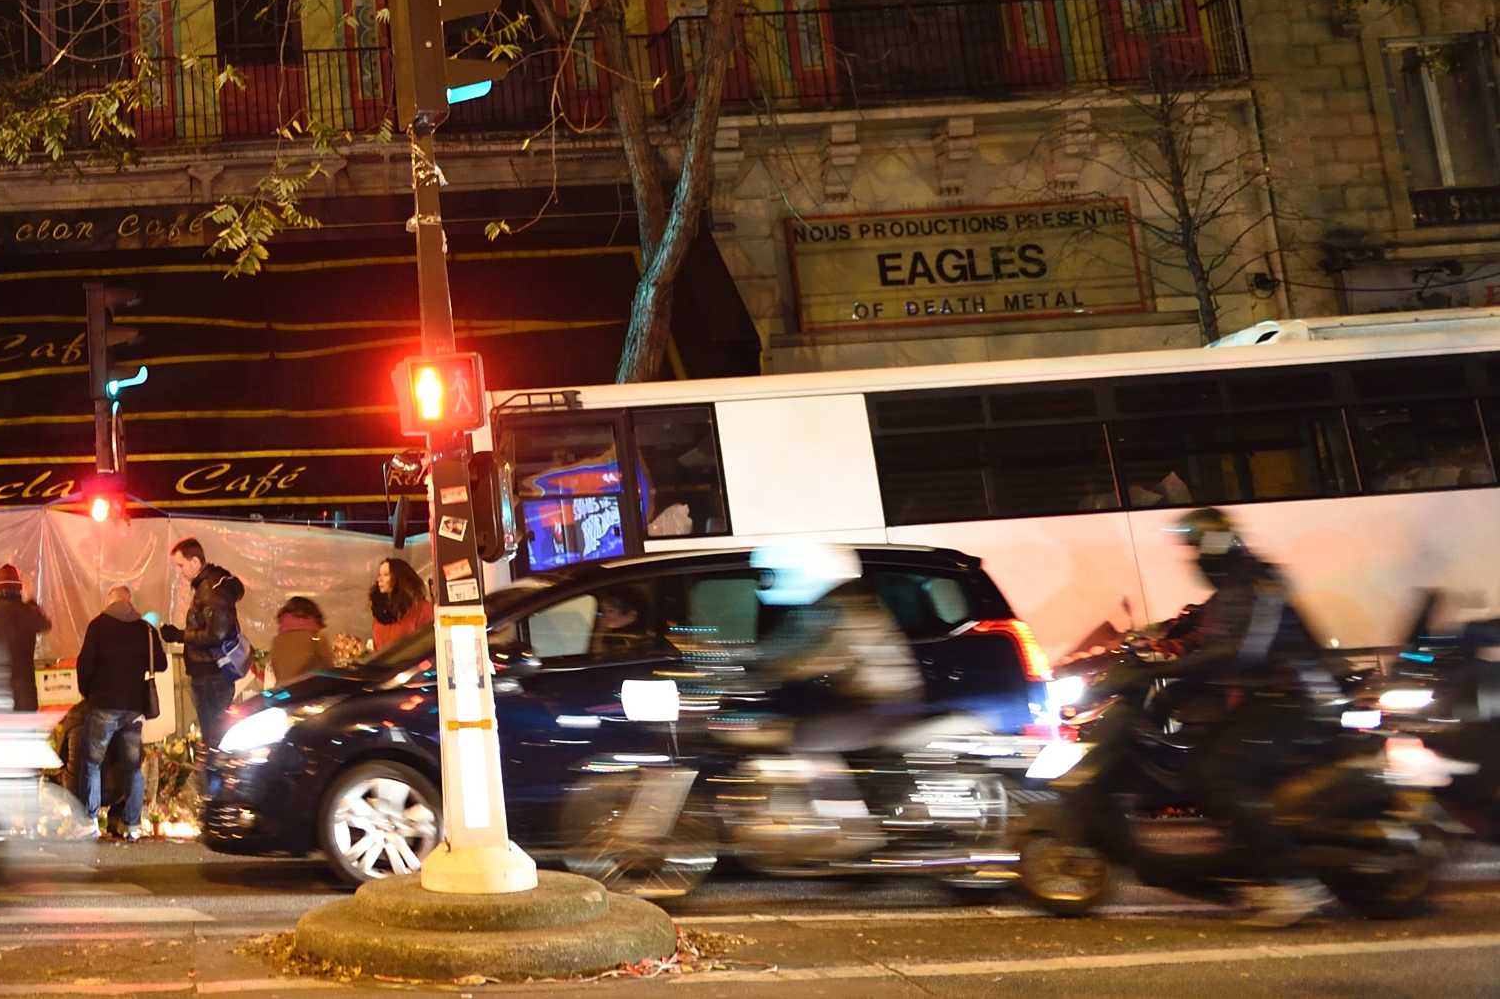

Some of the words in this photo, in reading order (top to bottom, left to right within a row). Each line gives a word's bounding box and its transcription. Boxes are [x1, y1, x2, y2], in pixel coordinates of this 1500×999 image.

[15, 217, 94, 243] clan
[792, 222, 852, 245] NOUS
[859, 210, 1009, 241] PRODUCTIONS
[877, 242, 1048, 287] EAGLES
[851, 302, 885, 321] OF
[906, 297, 986, 317] DEATH
[1004, 290, 1084, 312] METAL
[175, 462, 307, 500] Café
